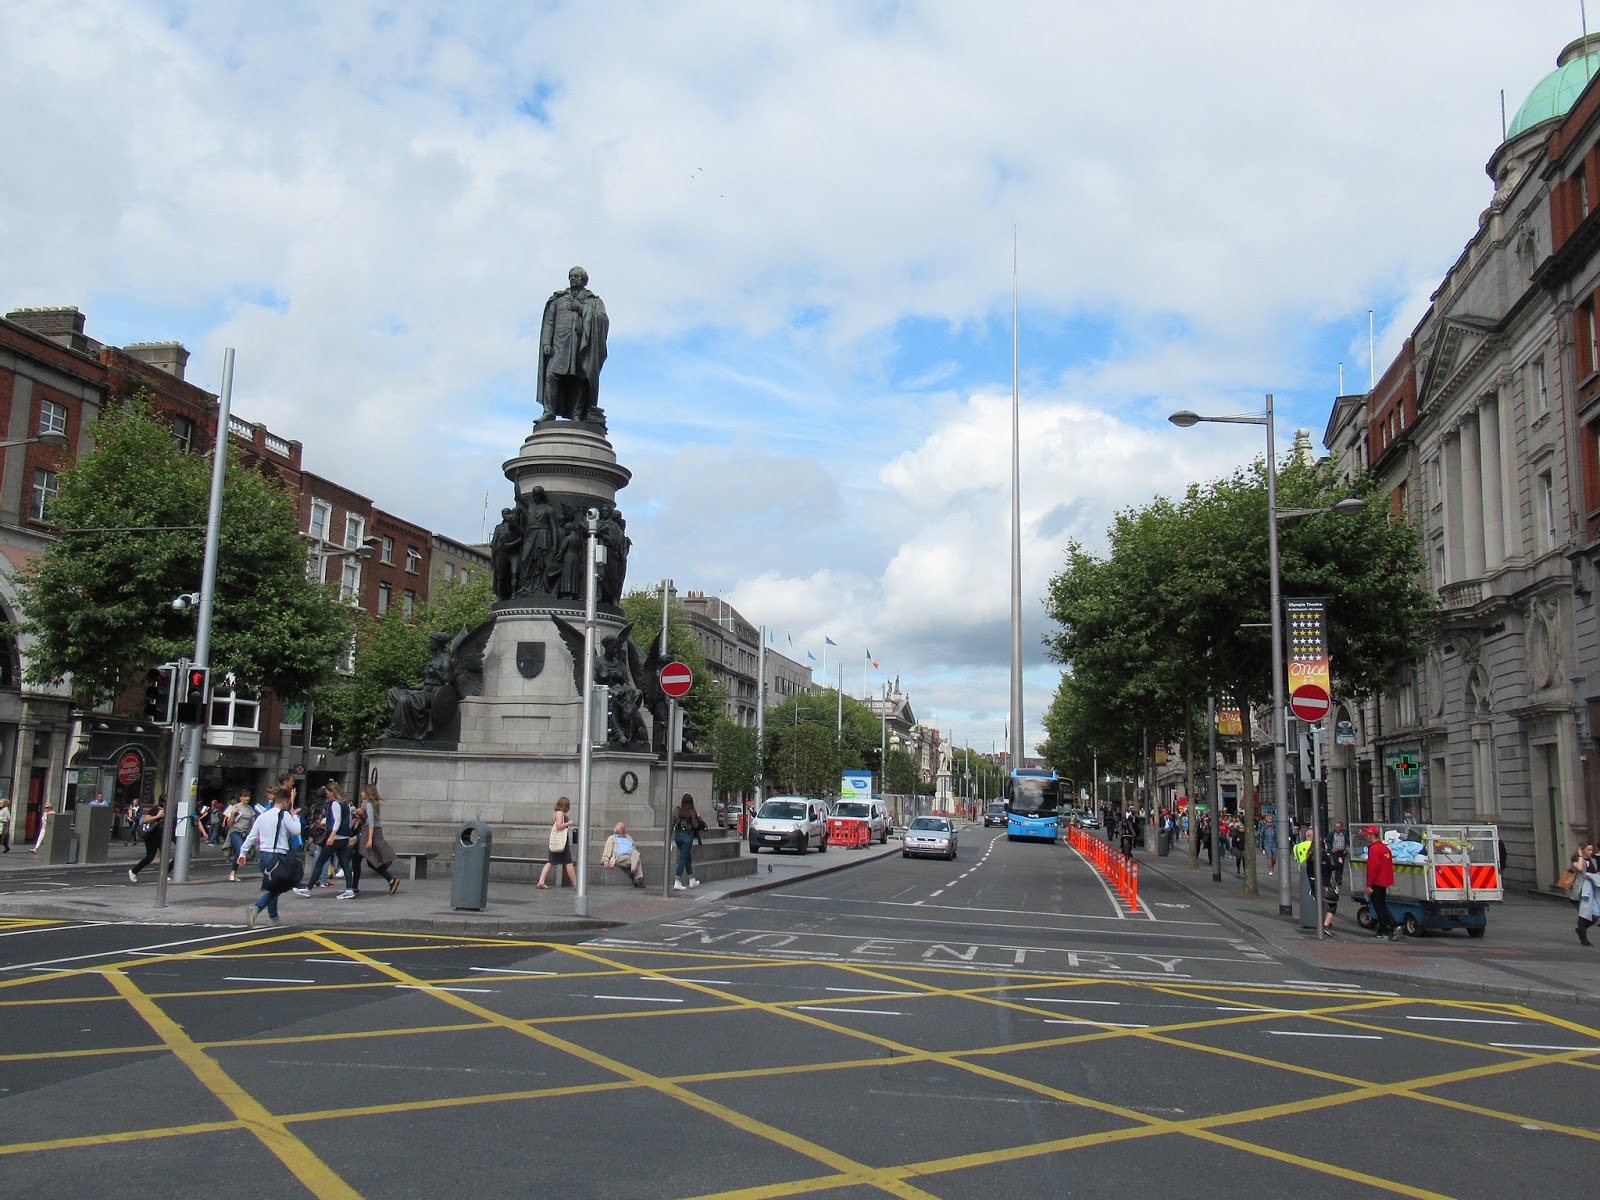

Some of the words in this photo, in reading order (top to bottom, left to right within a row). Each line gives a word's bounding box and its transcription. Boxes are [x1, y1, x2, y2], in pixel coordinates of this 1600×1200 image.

[1290, 662, 1326, 676] Once
[664, 929, 799, 948] NO
[850, 939, 1183, 973] ENTRY
